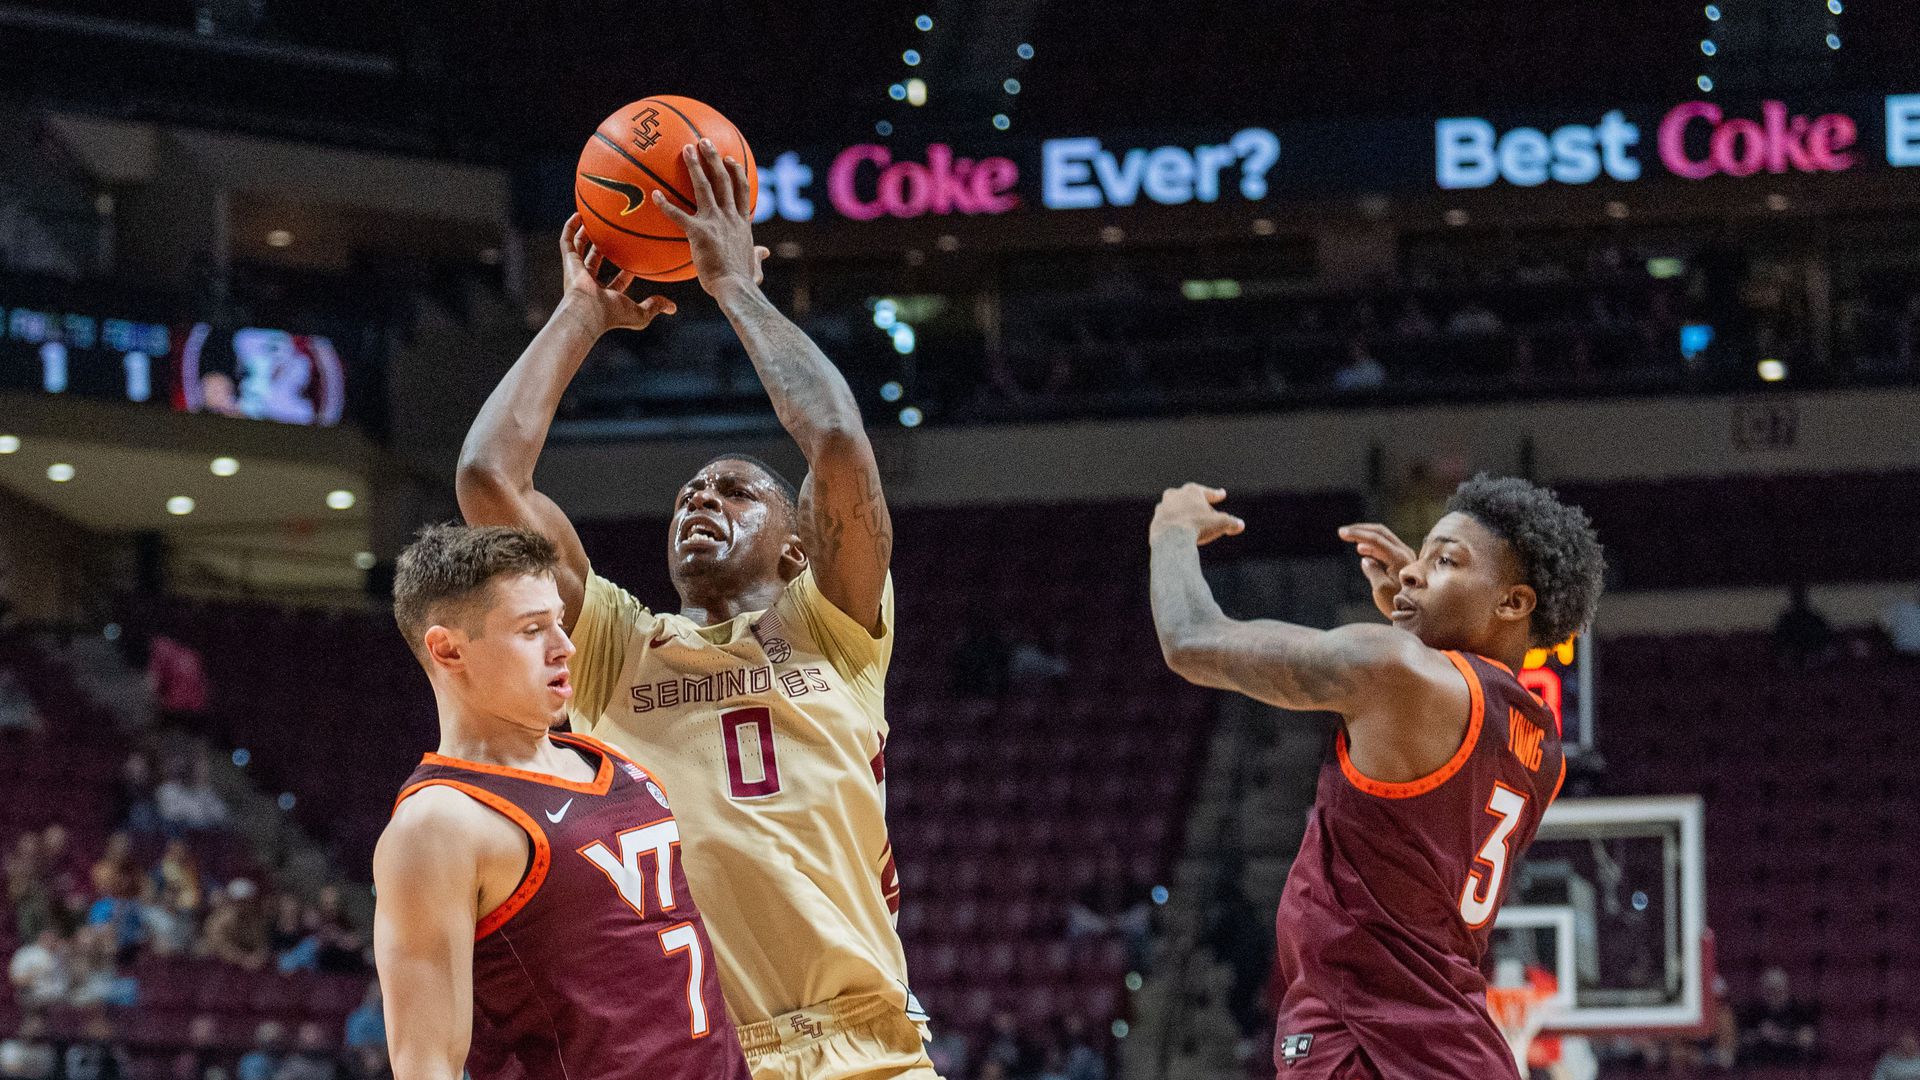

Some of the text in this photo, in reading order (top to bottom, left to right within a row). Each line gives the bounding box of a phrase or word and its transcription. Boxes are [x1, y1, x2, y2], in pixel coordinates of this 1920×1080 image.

[752, 127, 1281, 224] st Coke Ever?
[1434, 108, 1643, 190] Best
[1657, 99, 1858, 179] Coke
[631, 666, 831, 713] SEMINOES
[717, 705, 784, 800] 0
[576, 817, 681, 919] VT
[1457, 779, 1530, 929] 3
[657, 921, 710, 1039] 7
[791, 1014, 823, 1038] FSU
